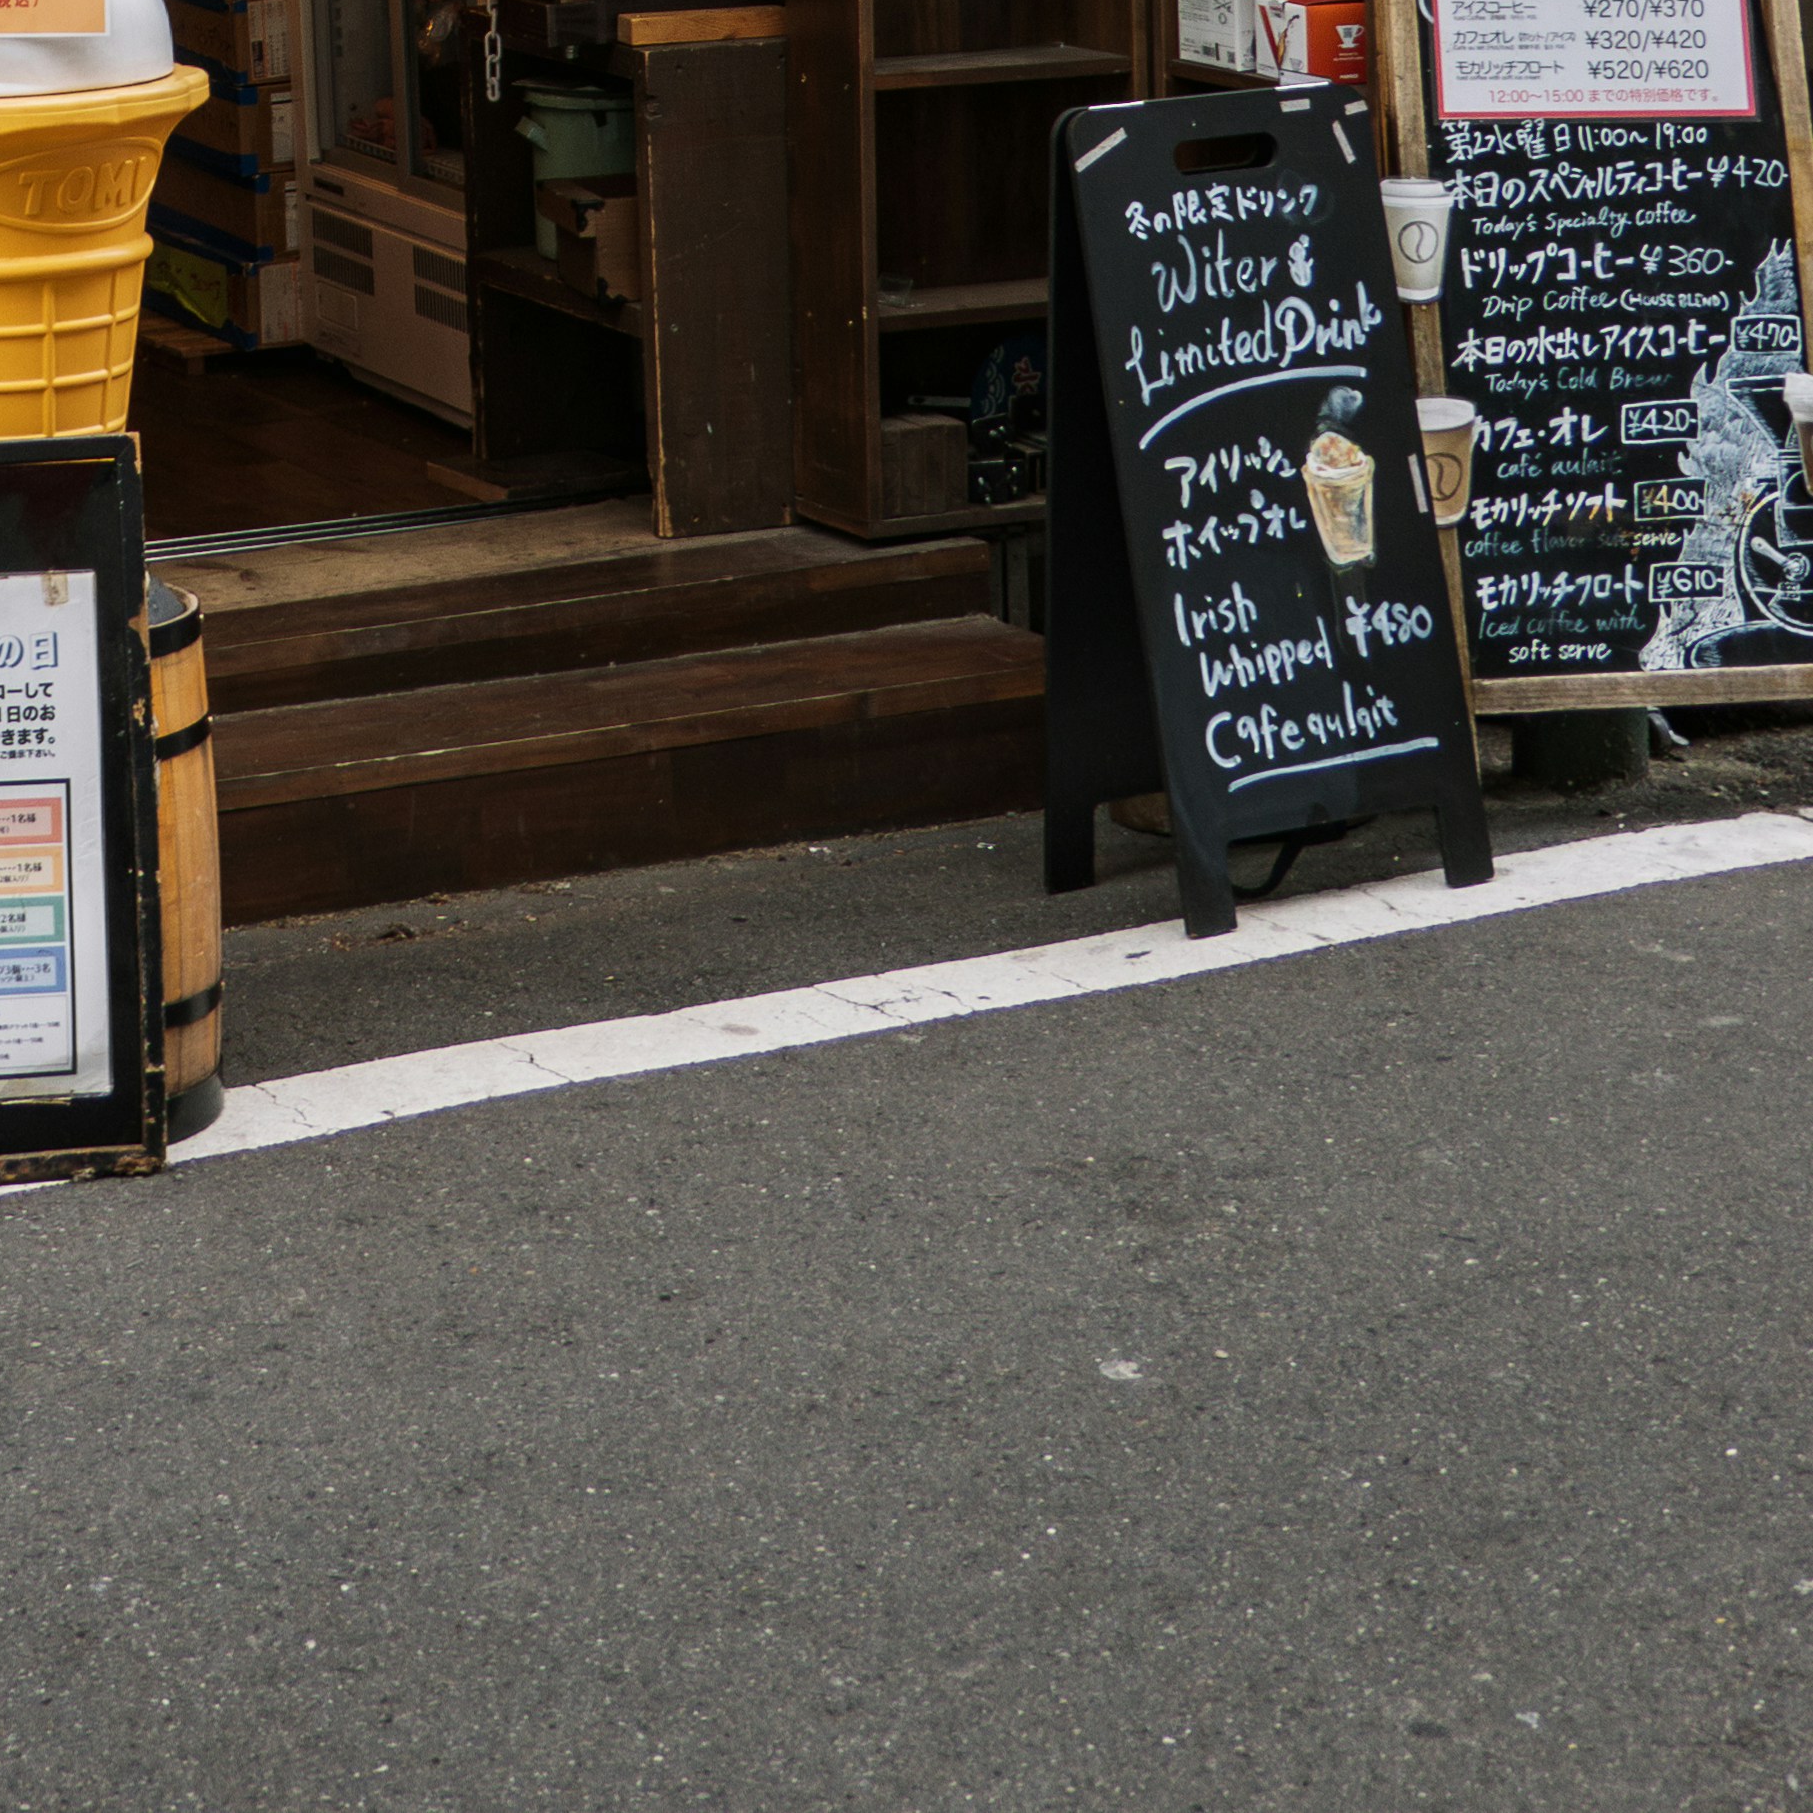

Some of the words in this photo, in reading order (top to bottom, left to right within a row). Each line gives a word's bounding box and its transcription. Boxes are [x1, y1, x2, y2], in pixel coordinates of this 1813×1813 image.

[1451, 0, 1537, 14] アイスコーヒー
[1453, 31, 1515, 45] カフェオレ
[1584, 30, 1707, 52] ¥320/¥420
[1455, 60, 1565, 75] モカリッチフロート
[1587, 59, 1710, 82] ¥520/¥620
[1588, 88, 1720, 104] までの特別価格です。
[1124, 181, 1319, 241] 冬の限定ドリンク
[1471, 213, 1538, 242] Today's
[1543, 205, 1631, 241] Specialty
[1150, 228, 1279, 313] Witer
[1459, 242, 1635, 289] ドリップコーヒー
[1481, 294, 1533, 320] Drip
[1124, 298, 1279, 407] Limited
[1274, 280, 1383, 369] Drink
[1451, 320, 1726, 373] 本日の水出しアイスコーヒー
[1484, 372, 1550, 400] Today's
[1556, 368, 1597, 390] Cold
[1163, 435, 1297, 509] アイリッシュ
[1162, 488, 1307, 570] ホイップオレ
[1470, 481, 1629, 531] モカリッチソフト
[1464, 530, 1524, 558] coffee
[1632, 529, 1683, 548] serve
[1475, 563, 1645, 611] モカリッチフロート
[1174, 581, 1258, 647] Irish
[1478, 616, 1520, 640] Iced
[1596, 612, 1646, 632] with
[1507, 640, 1552, 663] soft
[1558, 642, 1613, 661] serve
[1205, 703, 1306, 769] Cafe
